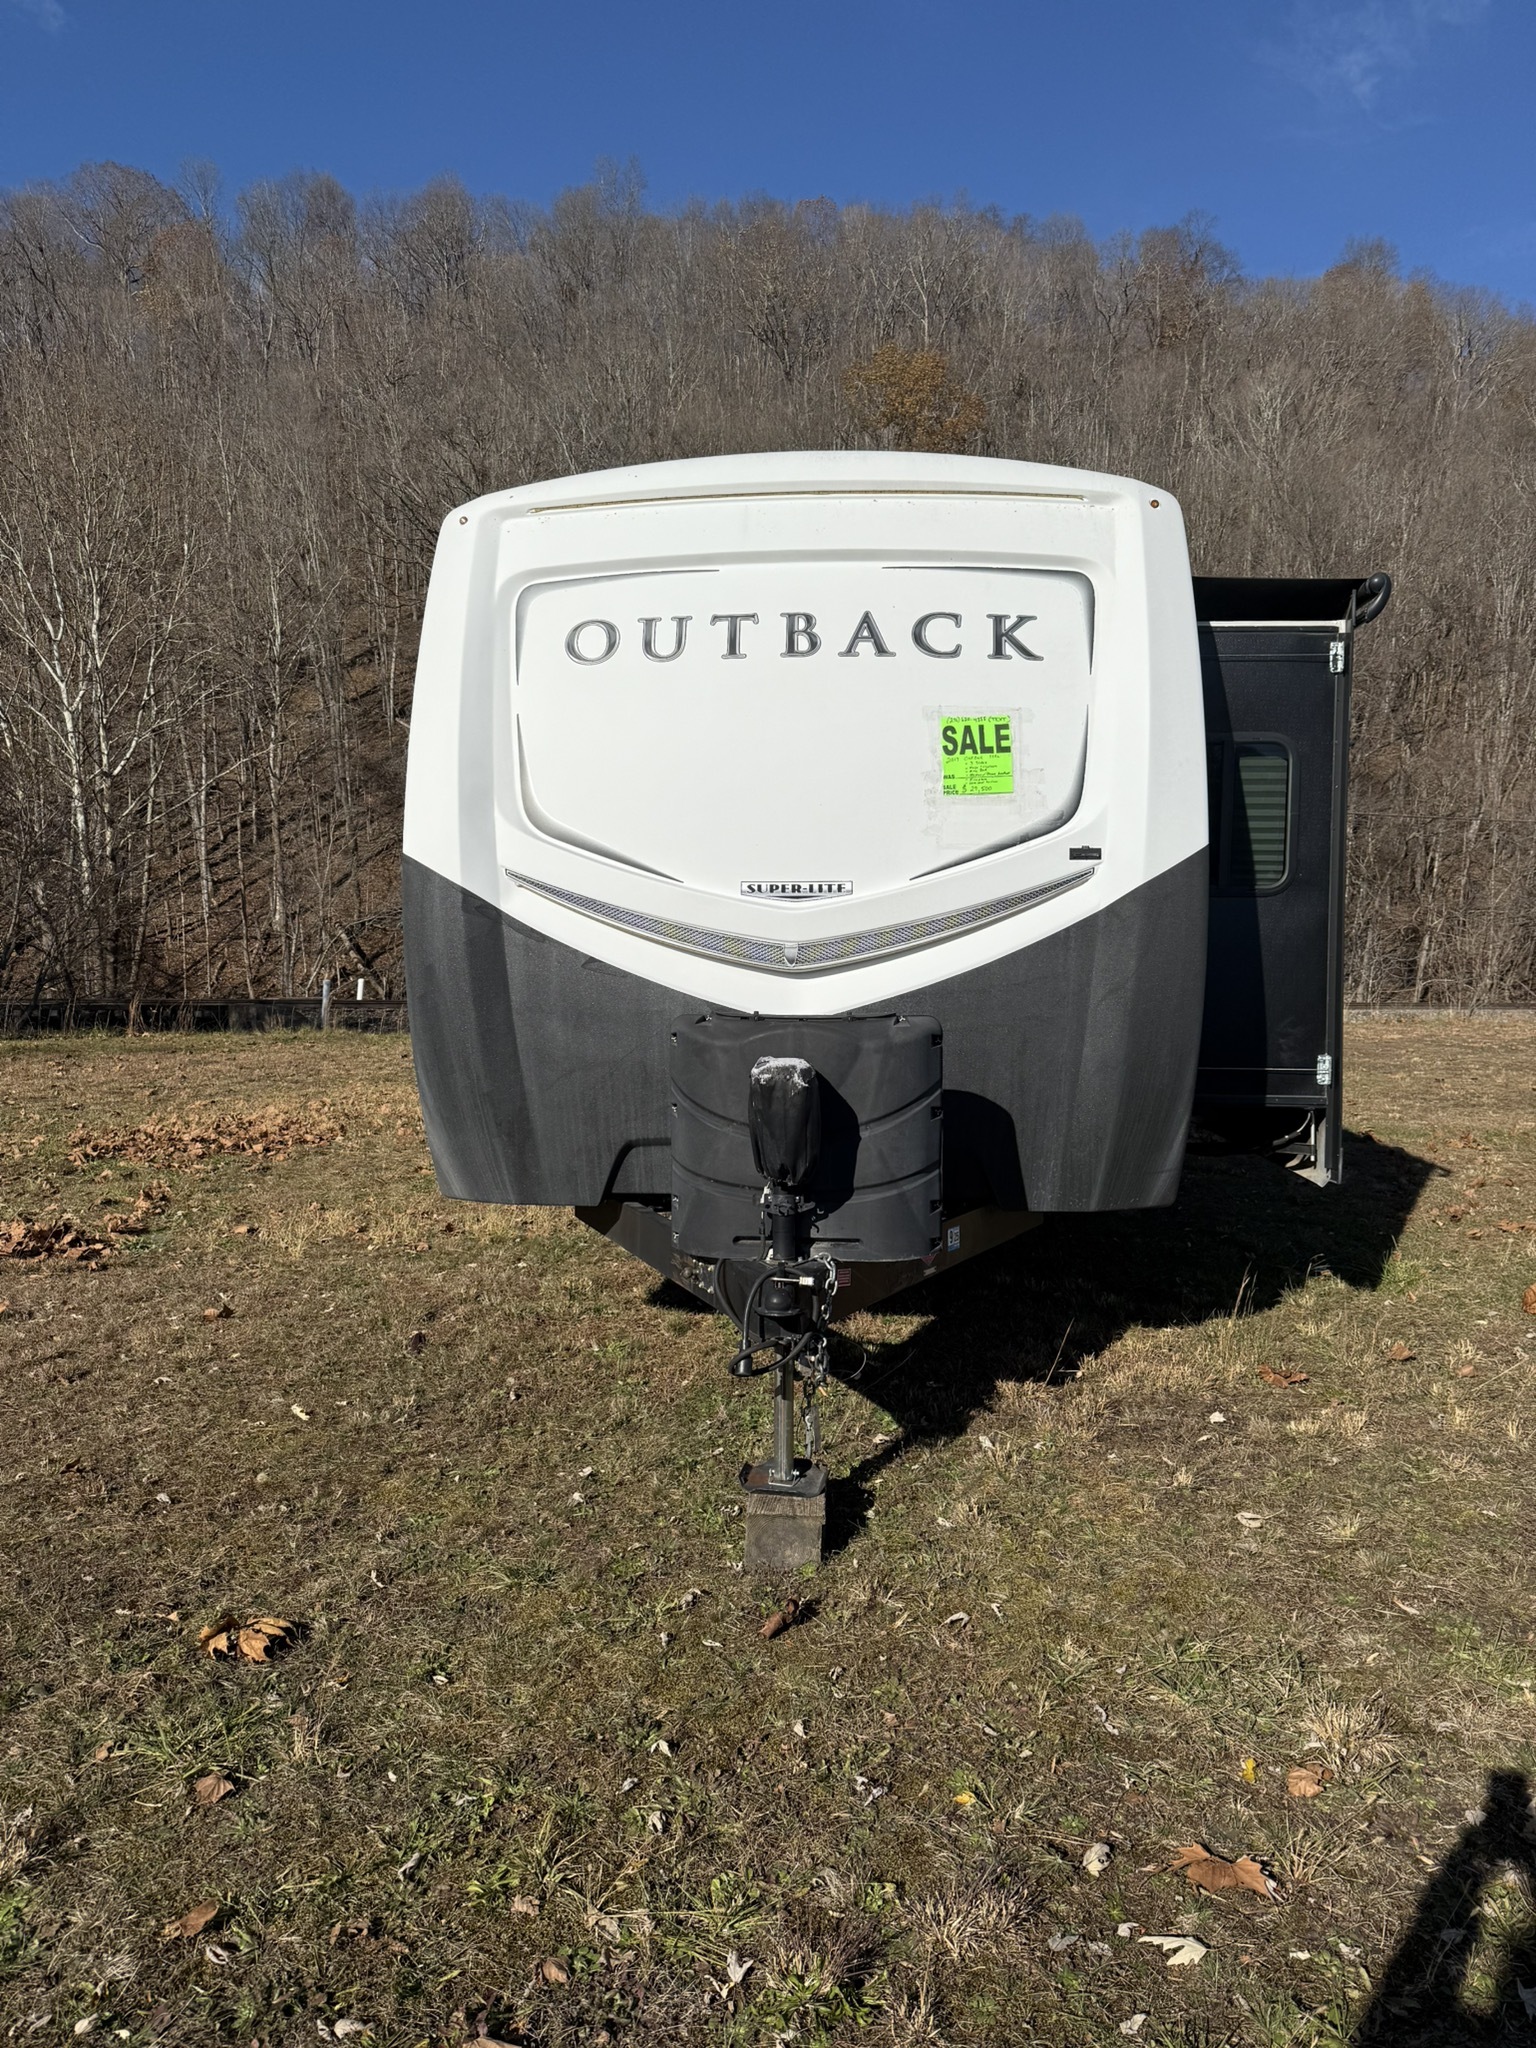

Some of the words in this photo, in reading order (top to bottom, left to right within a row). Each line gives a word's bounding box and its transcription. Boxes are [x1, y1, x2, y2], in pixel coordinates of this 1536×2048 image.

[564, 610, 1044, 665] OUTBACK
[942, 723, 1011, 756] SALE
[747, 883, 846, 894] SUPER-LITE
